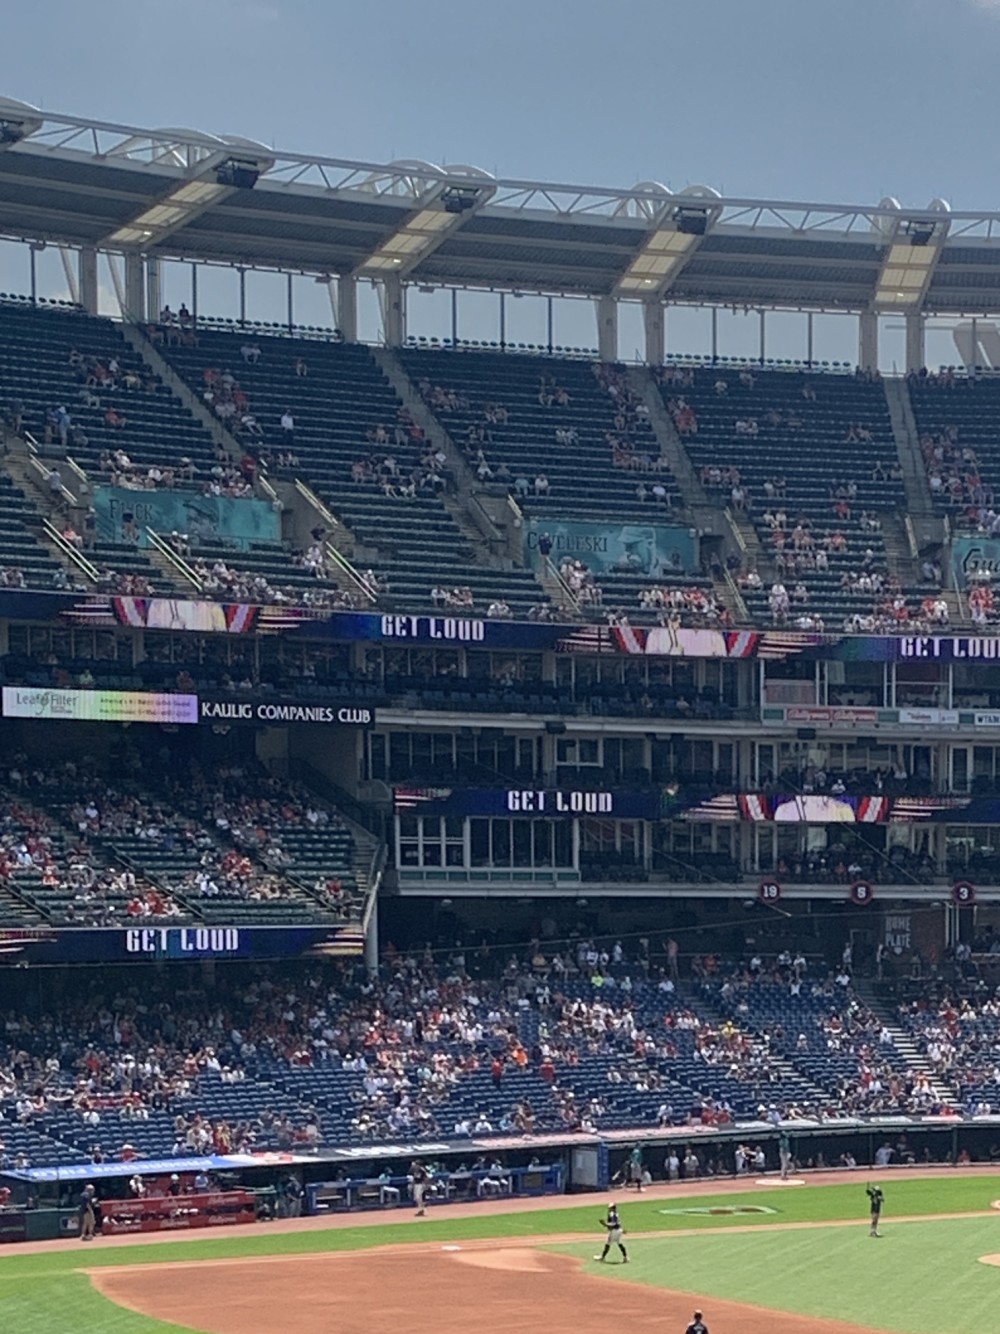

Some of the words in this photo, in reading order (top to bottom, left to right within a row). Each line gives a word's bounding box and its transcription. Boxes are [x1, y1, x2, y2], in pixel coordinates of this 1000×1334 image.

[527, 531, 608, 552] CVELESKI
[381, 615, 420, 637] GET
[427, 616, 485, 641] LOUD
[901, 637, 941, 657] GET
[201, 702, 253, 719] KAULIG
[257, 704, 334, 722] COMPANIES
[338, 708, 371, 724] CLUB
[508, 790, 548, 812] GET
[556, 791, 612, 813] LOUD
[763, 885, 778, 898] 19
[959, 887, 969, 900] 3
[126, 929, 171, 952] GET
[180, 928, 239, 951] LOUD
[885, 933, 911, 949] PLATE
